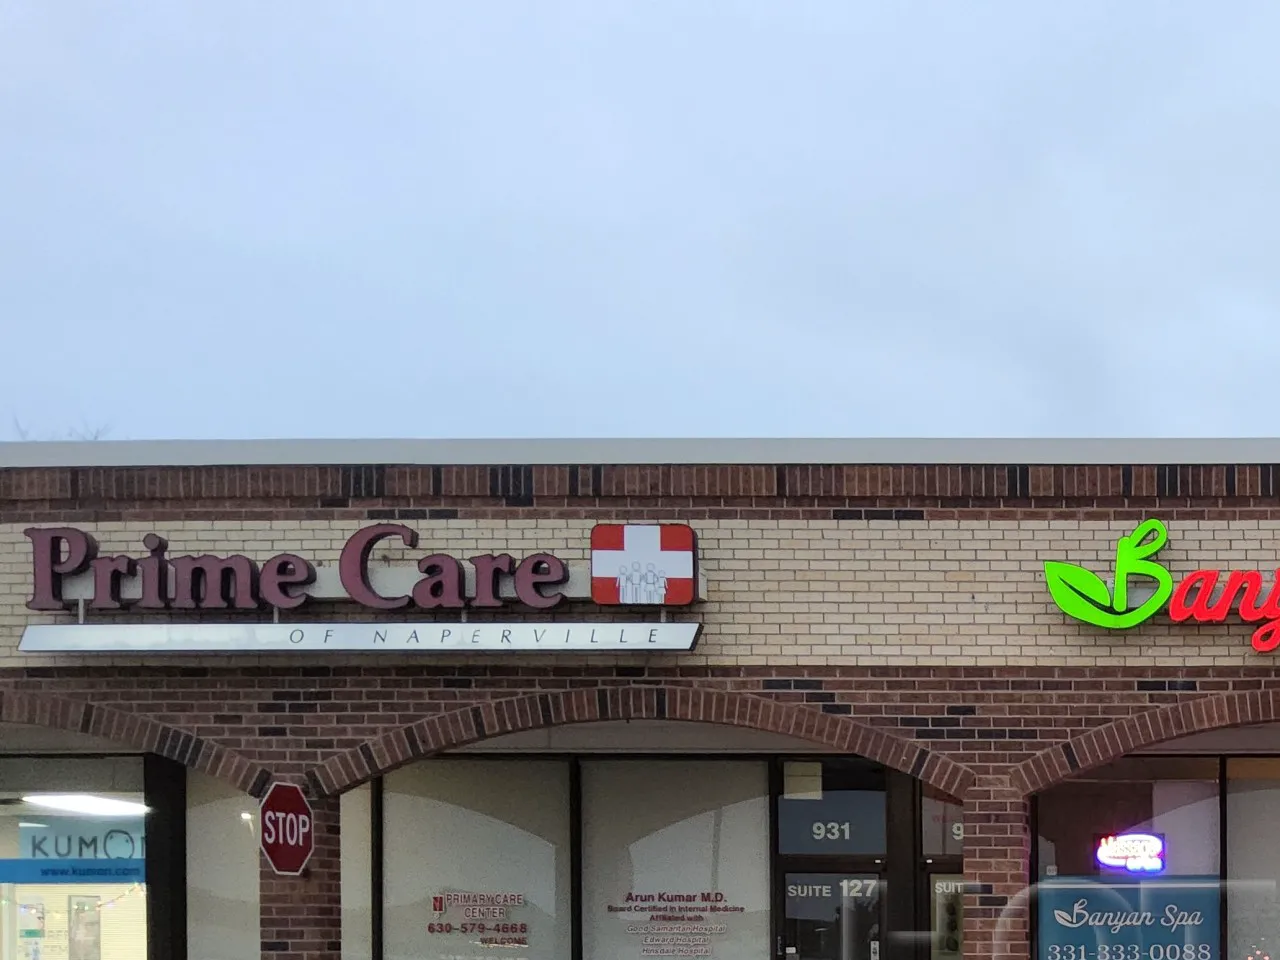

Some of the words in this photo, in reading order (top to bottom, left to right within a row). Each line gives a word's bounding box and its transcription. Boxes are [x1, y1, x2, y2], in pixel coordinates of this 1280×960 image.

[24, 525, 315, 610] Prime
[337, 523, 571, 610] Care
[289, 628, 338, 645] OF
[373, 628, 660, 645] NAPERVILLE
[264, 810, 310, 846] STOP
[811, 821, 851, 841] 931
[31, 829, 147, 860] KUMO
[625, 892, 655, 903] Arun
[658, 892, 698, 903] Kumar
[701, 892, 727, 903] M.D.
[787, 884, 832, 898] SUITE
[839, 878, 878, 898] 127
[446, 894, 494, 904] PRIMARY
[495, 894, 523, 904] CARE
[464, 907, 505, 918] CENTER
[1054, 898, 1154, 933] Banyan
[1160, 904, 1204, 933] Spa
